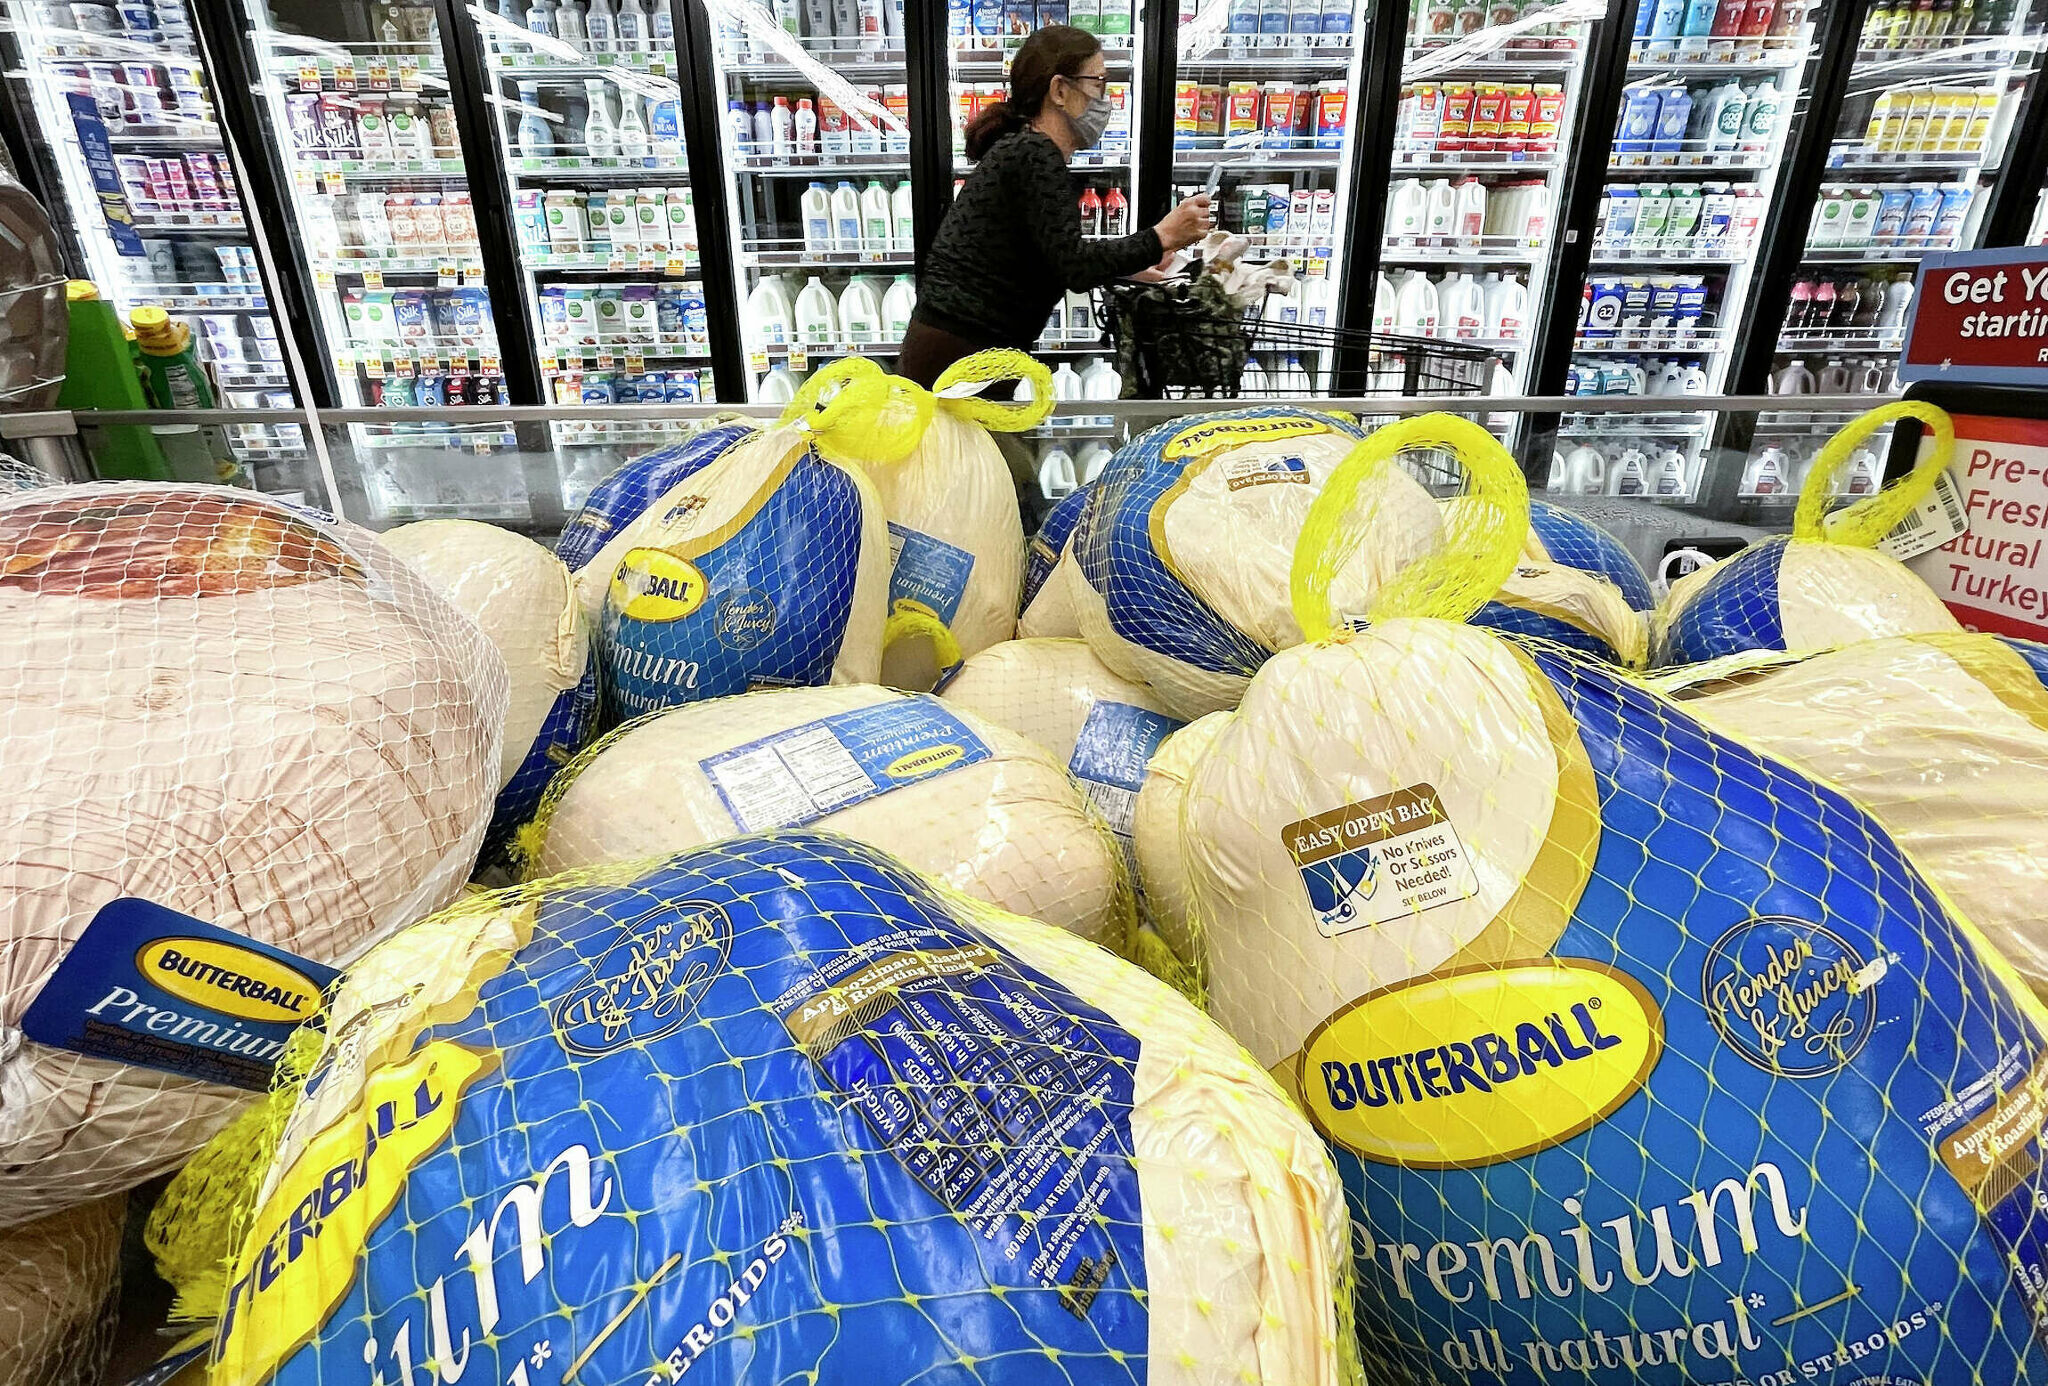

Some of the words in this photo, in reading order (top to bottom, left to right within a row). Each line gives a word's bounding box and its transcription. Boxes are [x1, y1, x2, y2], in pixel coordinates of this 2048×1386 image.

[292, 126, 323, 148] Silk
[322, 120, 356, 147] Silk
[1943, 270, 2009, 304] Get
[398, 305, 421, 321] Silk
[456, 304, 479, 320] Silk
[1598, 306, 1615, 319] a2
[450, 393, 464, 406] Silk
[477, 393, 492, 405] Silk
[1177, 419, 1315, 448] BUTTERBALL
[1938, 530, 2042, 569] atural
[896, 577, 955, 607] Premium
[721, 597, 765, 617] Tender
[721, 614, 731, 634] &
[732, 616, 772, 634] Juicy
[863, 725, 954, 759] Premium
[1125, 719, 1158, 782] Premium
[893, 748, 958, 773] BUTTERBALL
[1294, 826, 1342, 854] EASY
[1344, 809, 1396, 839] OPEN
[1394, 797, 1434, 823] BAG
[1381, 844, 1404, 861] No
[1407, 833, 1446, 855] Knives
[1389, 860, 1408, 876] Or
[1411, 847, 1458, 871] Scssors
[1394, 866, 1452, 893] Needed!
[1418, 886, 1448, 902] BELOW
[878, 933, 892, 944] DO
[158, 948, 303, 1014] BUTTERBALL
[564, 921, 673, 1025] Tender
[1712, 938, 1805, 1021] Tender
[831, 1002, 850, 1016] &
[848, 966, 929, 1005] Roasting
[888, 1019, 929, 1057] people)
[946, 1022, 979, 1052] (DAYS)
[1750, 1007, 1787, 1058] &
[919, 1053, 936, 1067] of
[955, 1048, 969, 1064] In
[971, 1056, 991, 1077] 3-4
[1015, 1053, 1036, 1068] 9-11
[902, 1058, 936, 1095] FEEDS
[1028, 1064, 1053, 1085] 11-12
[883, 1088, 910, 1122] (lbs)
[936, 1087, 959, 1110] 6-12
[999, 1087, 1021, 1109] 5-6
[1040, 1080, 1064, 1103] 12-15
[851, 1078, 896, 1135] WEIGHT
[950, 1103, 975, 1127] 12-15
[1015, 1104, 1034, 1125] 6-7
[898, 1122, 929, 1153] 10-18
[1953, 1091, 2032, 1159] Approximate
[928, 1152, 959, 1185] 22-24
[946, 1166, 976, 1200] 24-30
[972, 1218, 985, 1231] in
[1018, 1168, 1029, 1182] or
[984, 1208, 1010, 1240] water
[1022, 1183, 1034, 1198] 30
[1004, 1239, 1020, 1261] DO
[1015, 1220, 1034, 1243] NOT
[1044, 1192, 1059, 1211] AT
[1053, 1169, 1080, 1198] ROOM
[1045, 1243, 1055, 1252] a
[1050, 1212, 1078, 1244] shallow
[1040, 1278, 1050, 1289] a
[1055, 1240, 1074, 1264] rack
[1068, 1230, 1081, 1244] in
[1076, 1223, 1086, 1233] a
[1442, 1327, 1514, 1374] all
[1759, 1368, 1797, 1386] OR
